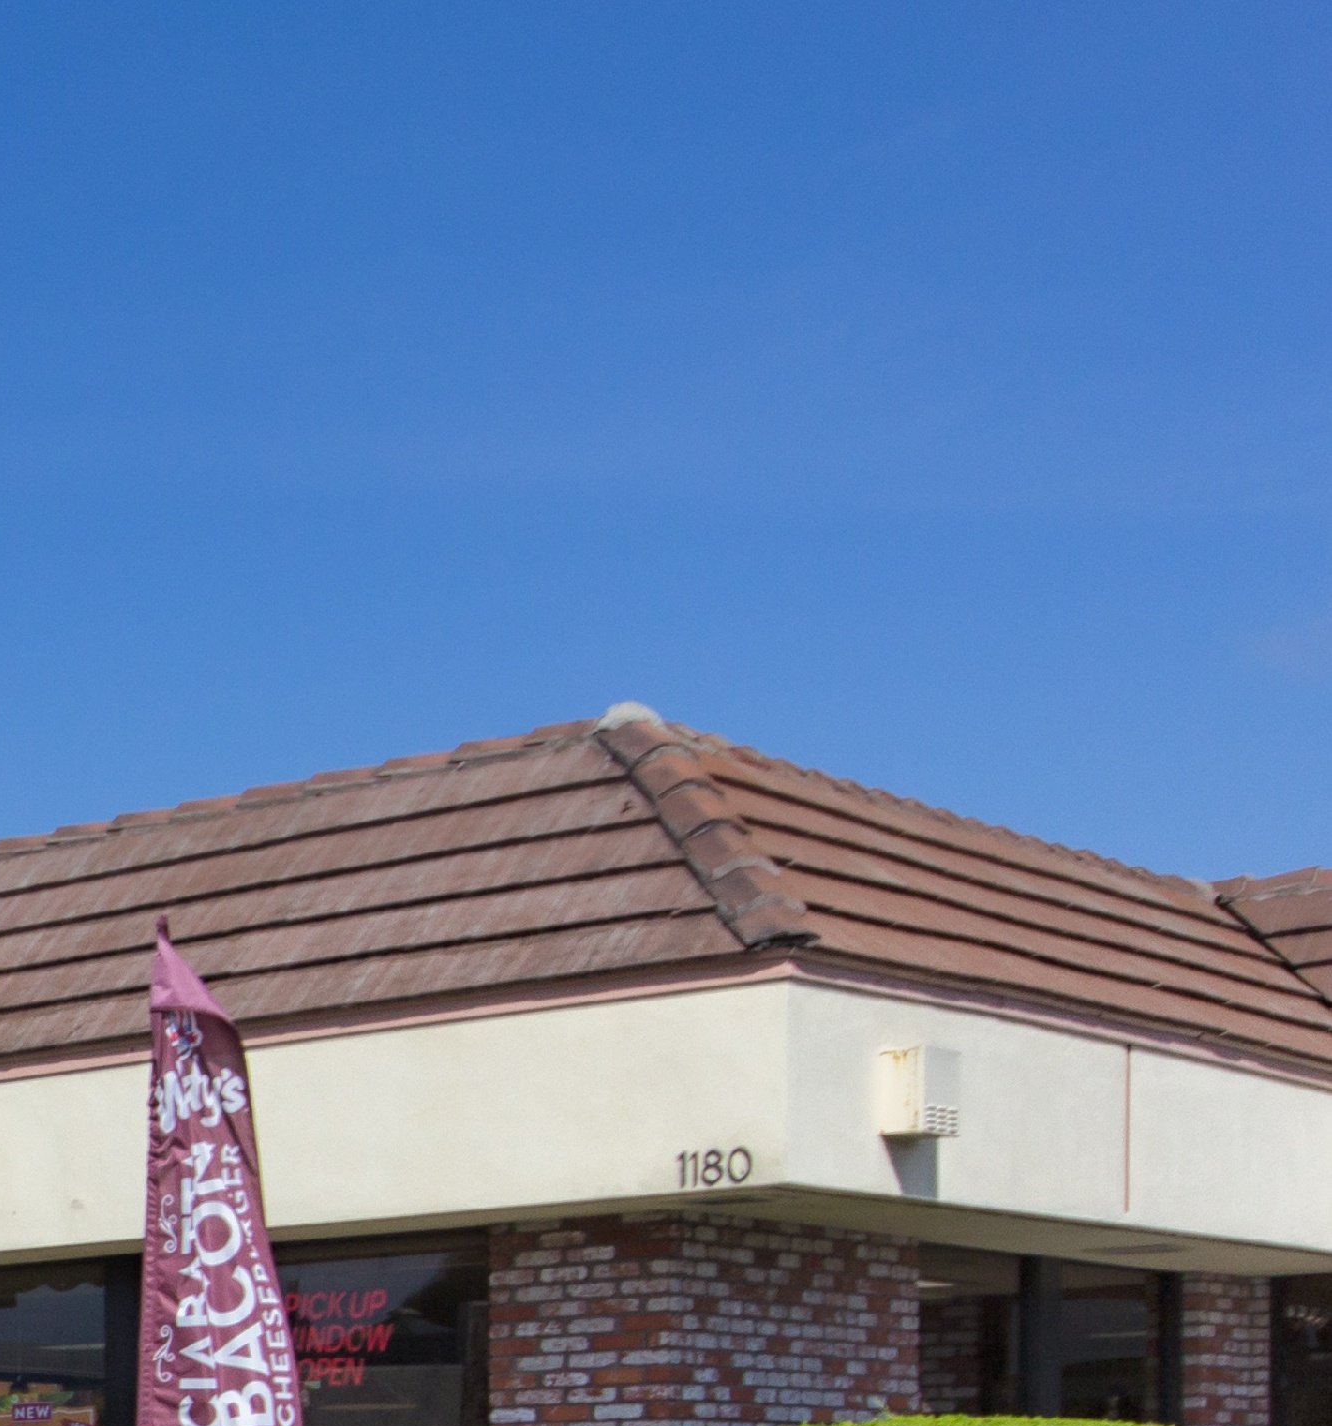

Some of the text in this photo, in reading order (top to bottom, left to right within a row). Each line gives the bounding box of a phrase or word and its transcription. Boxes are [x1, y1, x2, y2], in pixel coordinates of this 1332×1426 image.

[675, 1146, 753, 1189] 1180
[285, 1288, 388, 1319] PICK UP
[293, 1323, 395, 1352] INDOW
[298, 1357, 366, 1387] OPEN
[14, 1406, 51, 1419] NEW
